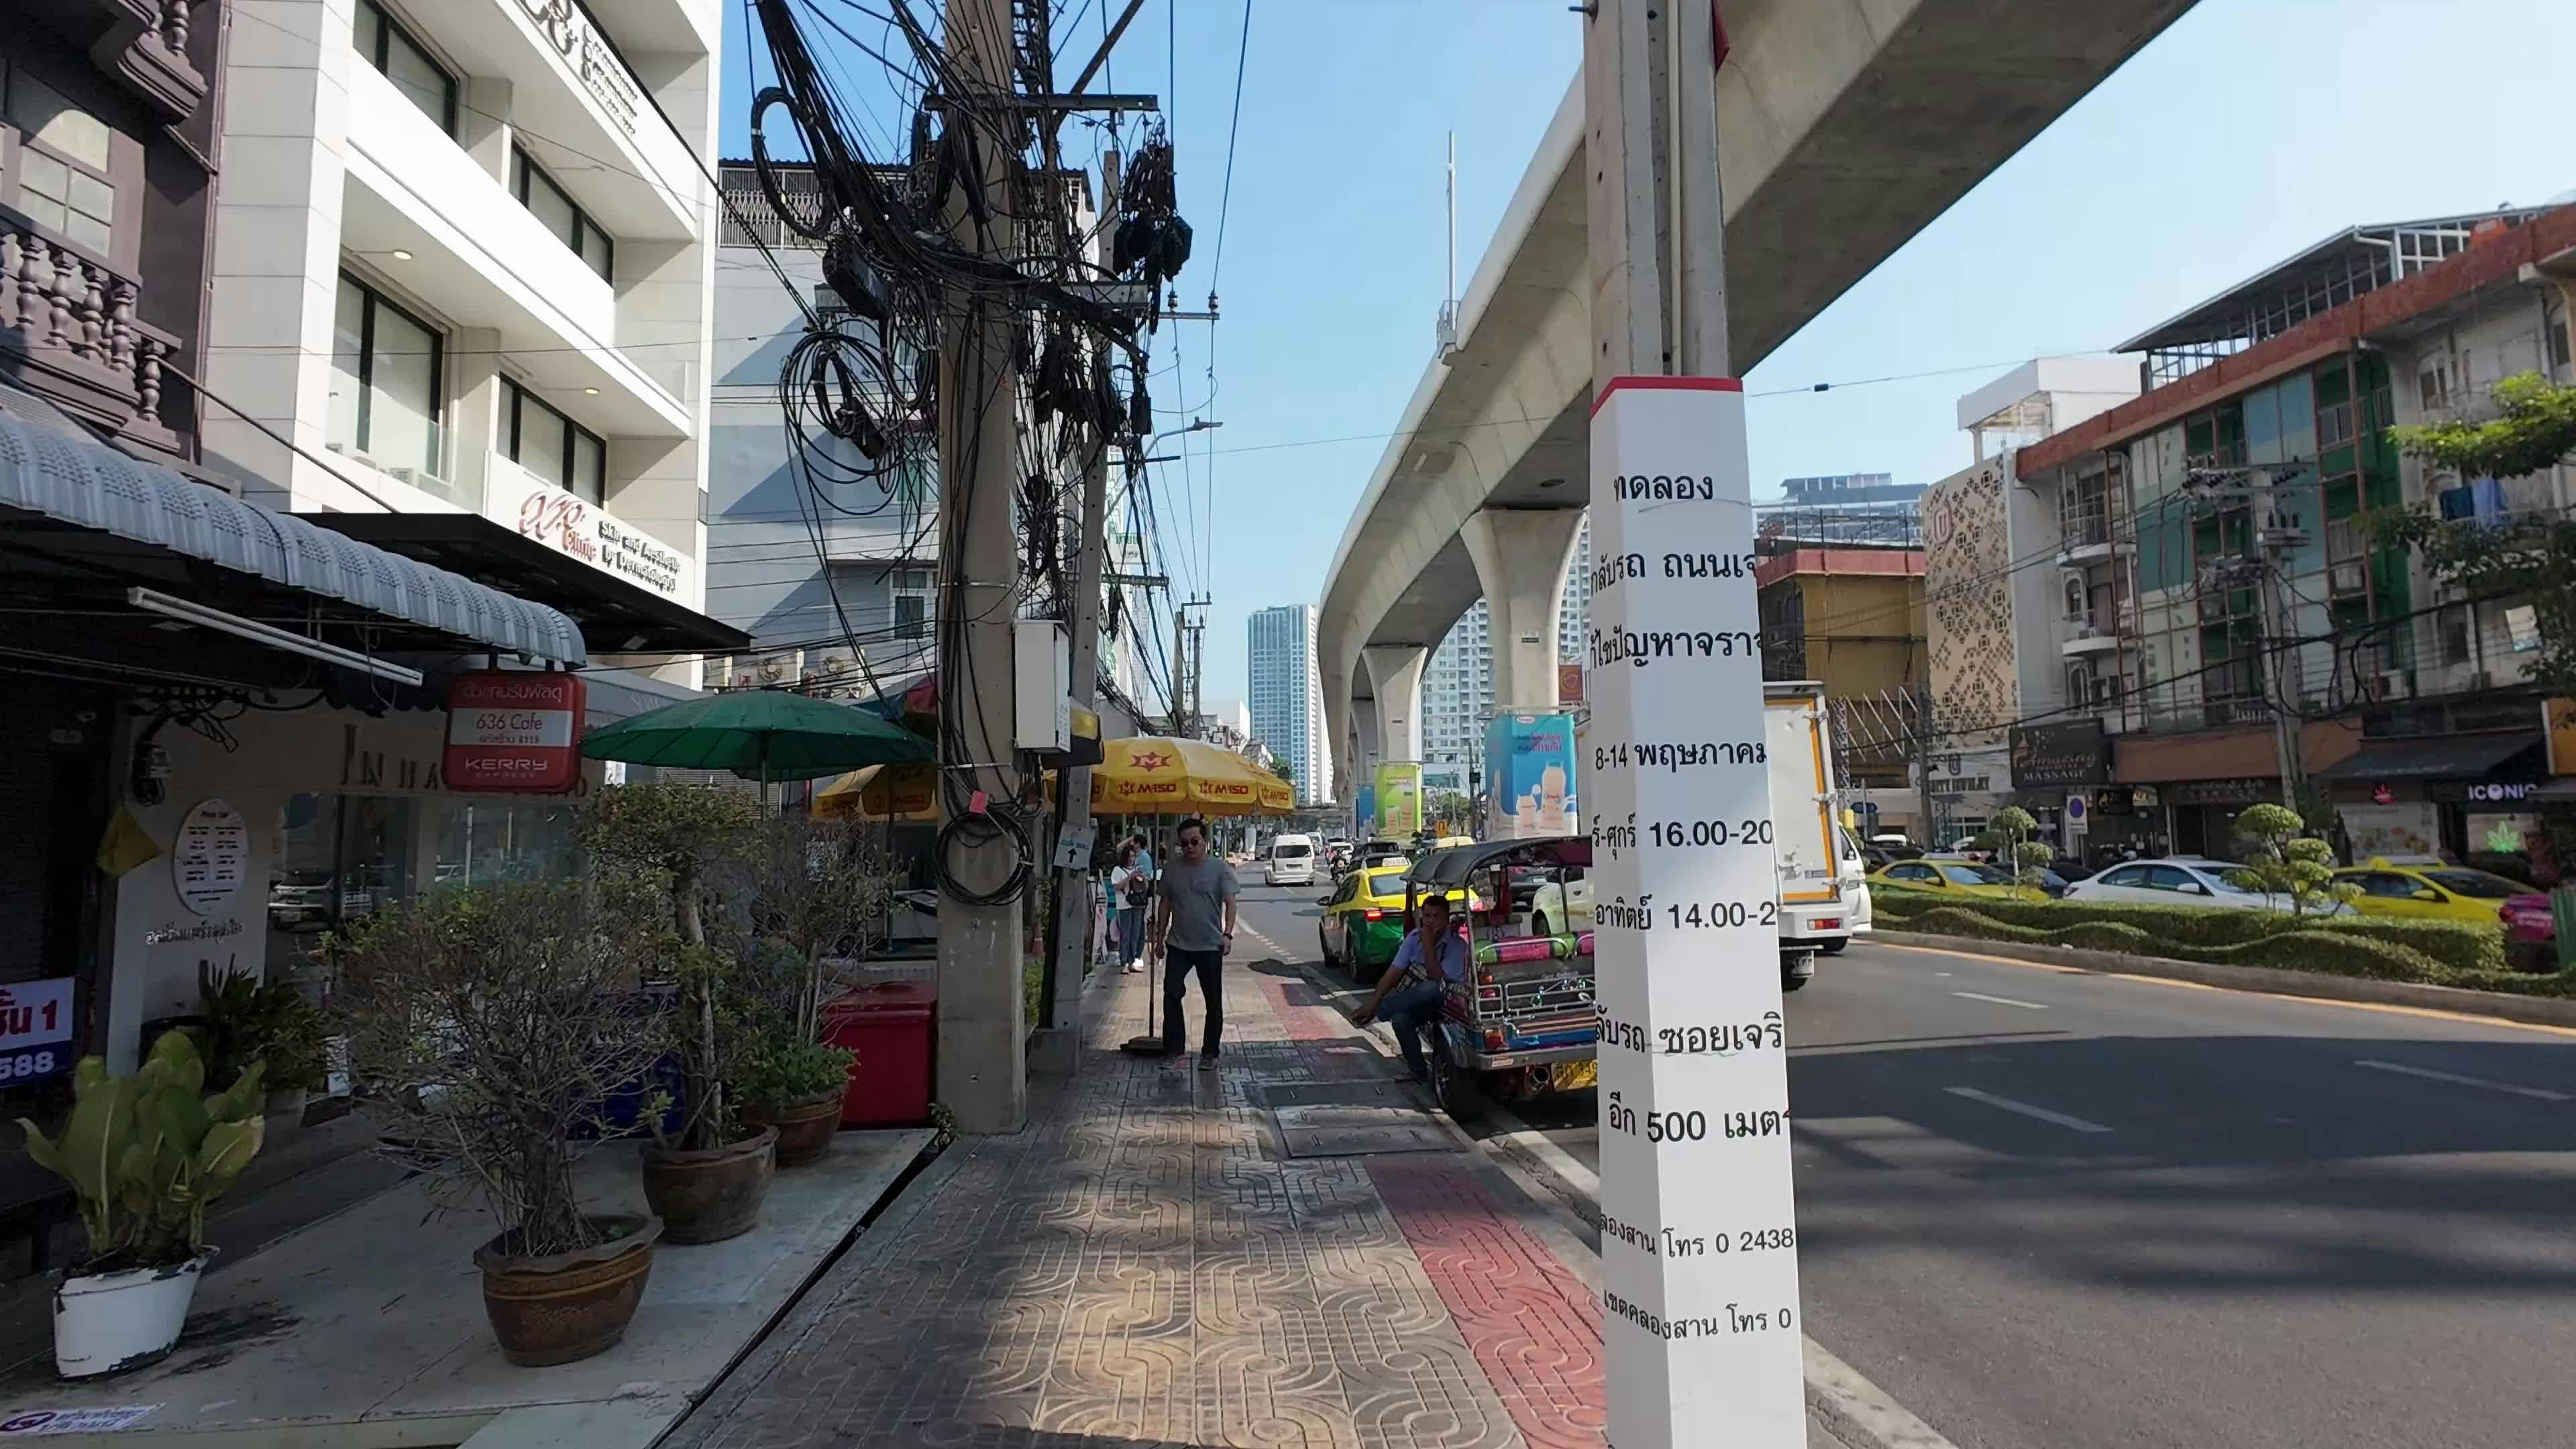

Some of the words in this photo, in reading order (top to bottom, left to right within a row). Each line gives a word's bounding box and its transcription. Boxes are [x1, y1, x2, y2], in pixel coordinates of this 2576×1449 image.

[1613, 474, 1714, 502] ทดลอง
[562, 529, 597, 563] Clinic
[1591, 553, 1646, 596] กลับรถ
[477, 713, 505, 730] 636
[511, 712, 543, 730] Cafe
[464, 757, 548, 771] KERRY
[1595, 742, 1628, 771] 8-14
[1634, 742, 1767, 773] พฤษภาคม
[1137, 783, 1177, 793] M-150
[1215, 785, 1249, 795] M-150
[1649, 820, 1772, 848] 16.00-20
[1596, 894, 1652, 930] อาทิตย์
[1668, 902, 1776, 929] 14.00-2
[43, 1000, 57, 1030] 1
[1659, 1011, 1782, 1053] ซอยเจริ
[0, 1051, 54, 1081] 588
[1609, 1091, 1636, 1136] อีก
[1647, 1111, 1706, 1142] 500
[1662, 1228, 1705, 1258] โทร
[1715, 1234, 1729, 1253] 0
[1739, 1228, 1794, 1252] 2438
[1604, 1289, 1718, 1339] เขตคลองสาน
[1725, 1304, 1766, 1336] โทร
[1778, 1308, 1791, 1328] 0
